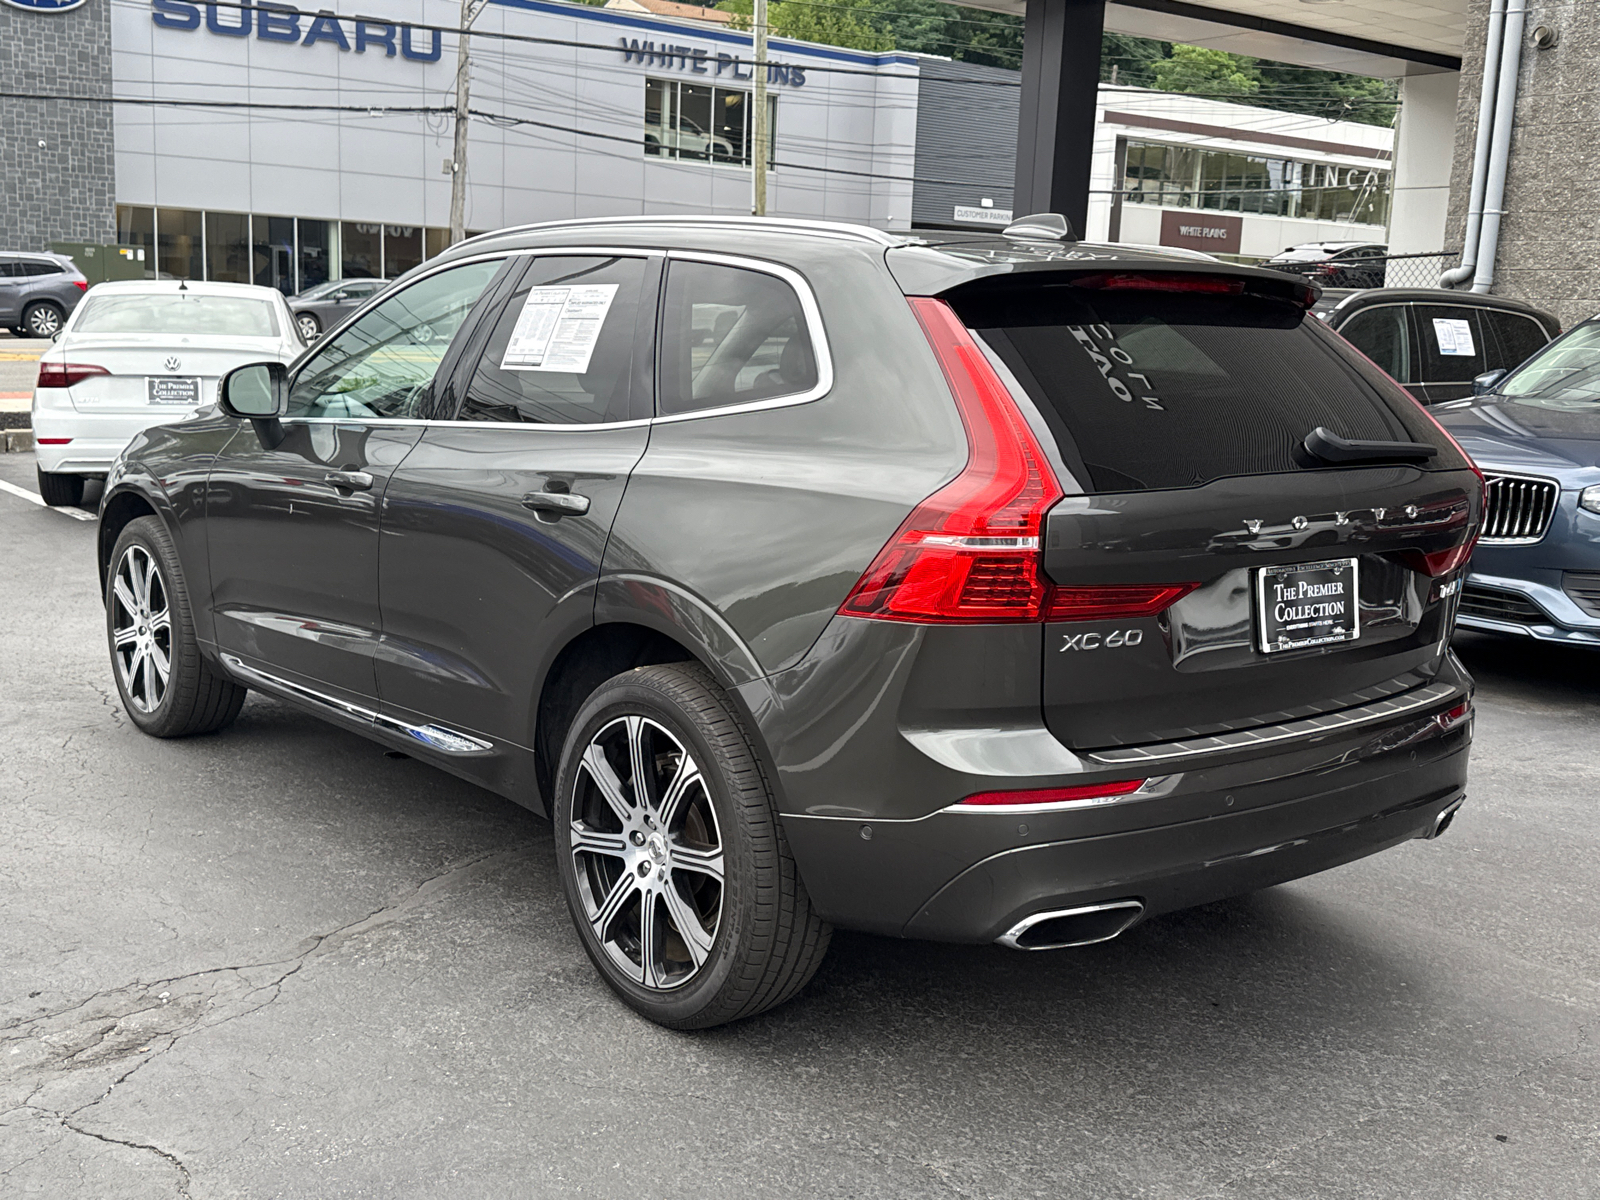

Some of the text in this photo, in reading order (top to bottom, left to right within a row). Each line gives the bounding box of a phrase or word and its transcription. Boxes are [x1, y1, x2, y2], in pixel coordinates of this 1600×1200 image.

[152, 0, 442, 63] SUBARU
[619, 37, 807, 88] WHITE PLINS
[956, 210, 1011, 221] CUSTOMER PARKIN
[1179, 226, 1227, 239] WHITE PLAINS
[153, 382, 195, 390] THE PREMIER
[1243, 504, 1418, 535] VOLVO
[1274, 581, 1344, 602] THE PREMIER
[1274, 601, 1345, 622] COLLECTION
